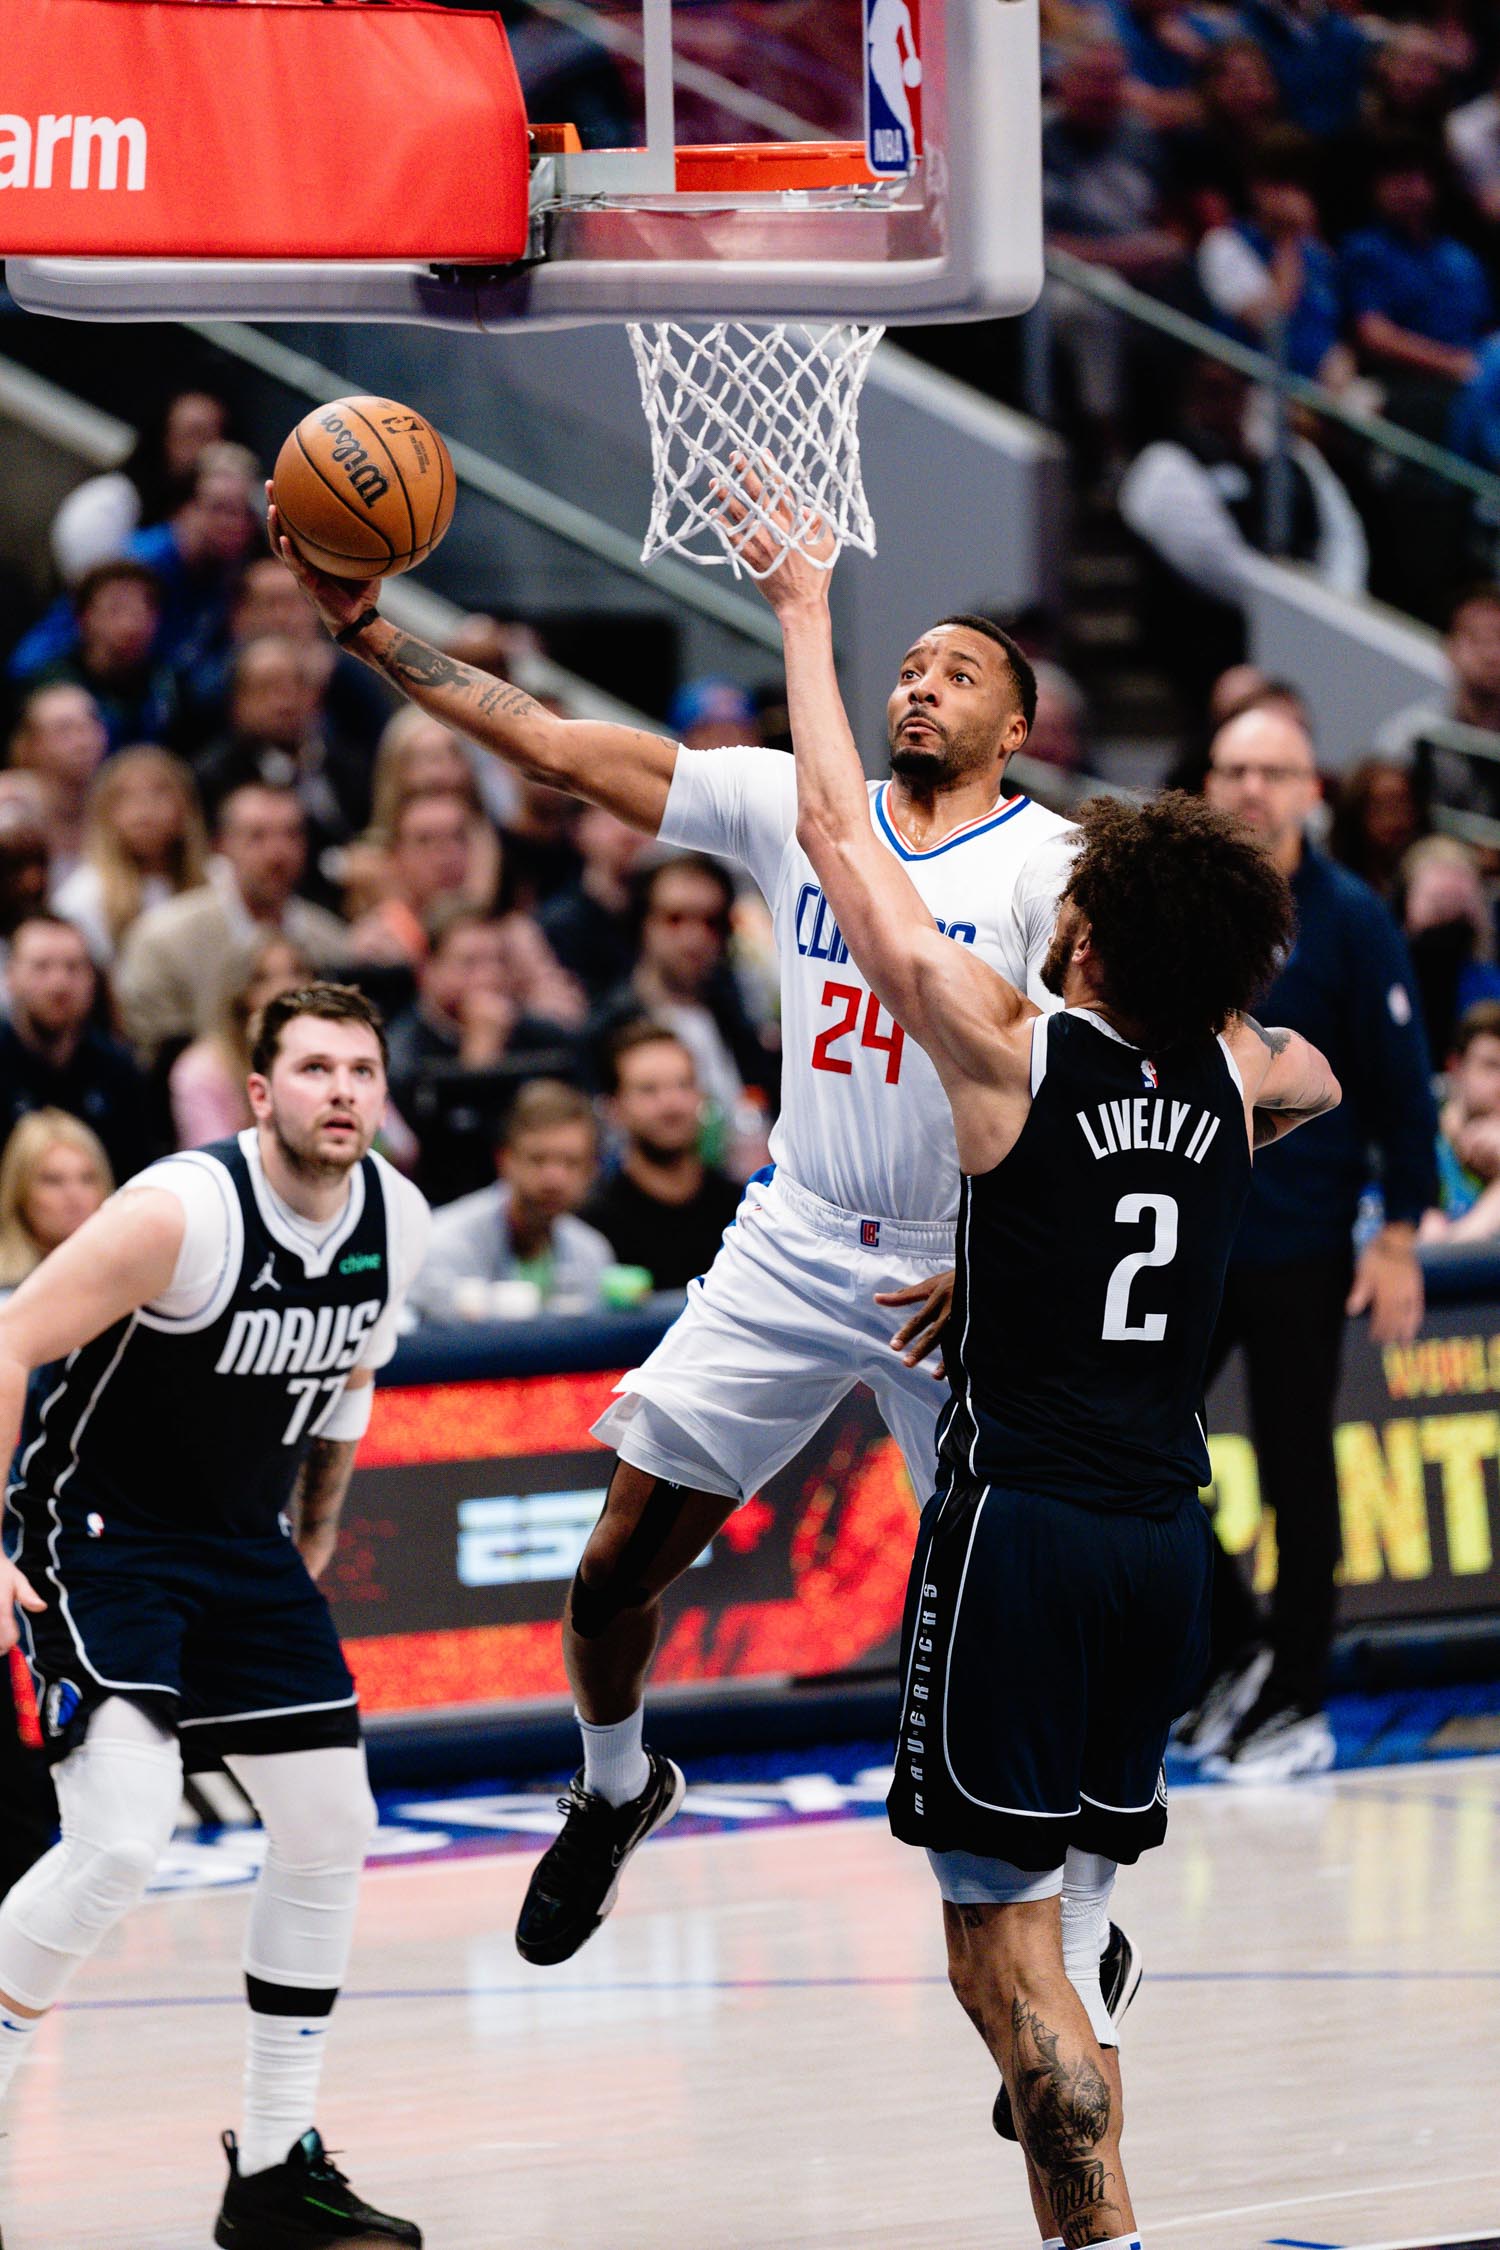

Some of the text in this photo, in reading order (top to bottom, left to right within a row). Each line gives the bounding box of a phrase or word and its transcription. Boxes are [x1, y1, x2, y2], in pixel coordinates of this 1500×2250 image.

[0, 114, 147, 191] arm
[874, 128, 904, 162] NBA
[811, 980, 905, 1085] 24
[1076, 1098, 1221, 1164] LIVELY II
[1101, 1193, 1179, 1341] 2
[214, 1299, 381, 1375] MAVS
[281, 1373, 350, 1445] 77
[907, 1583, 938, 1816] MAVERICKS
